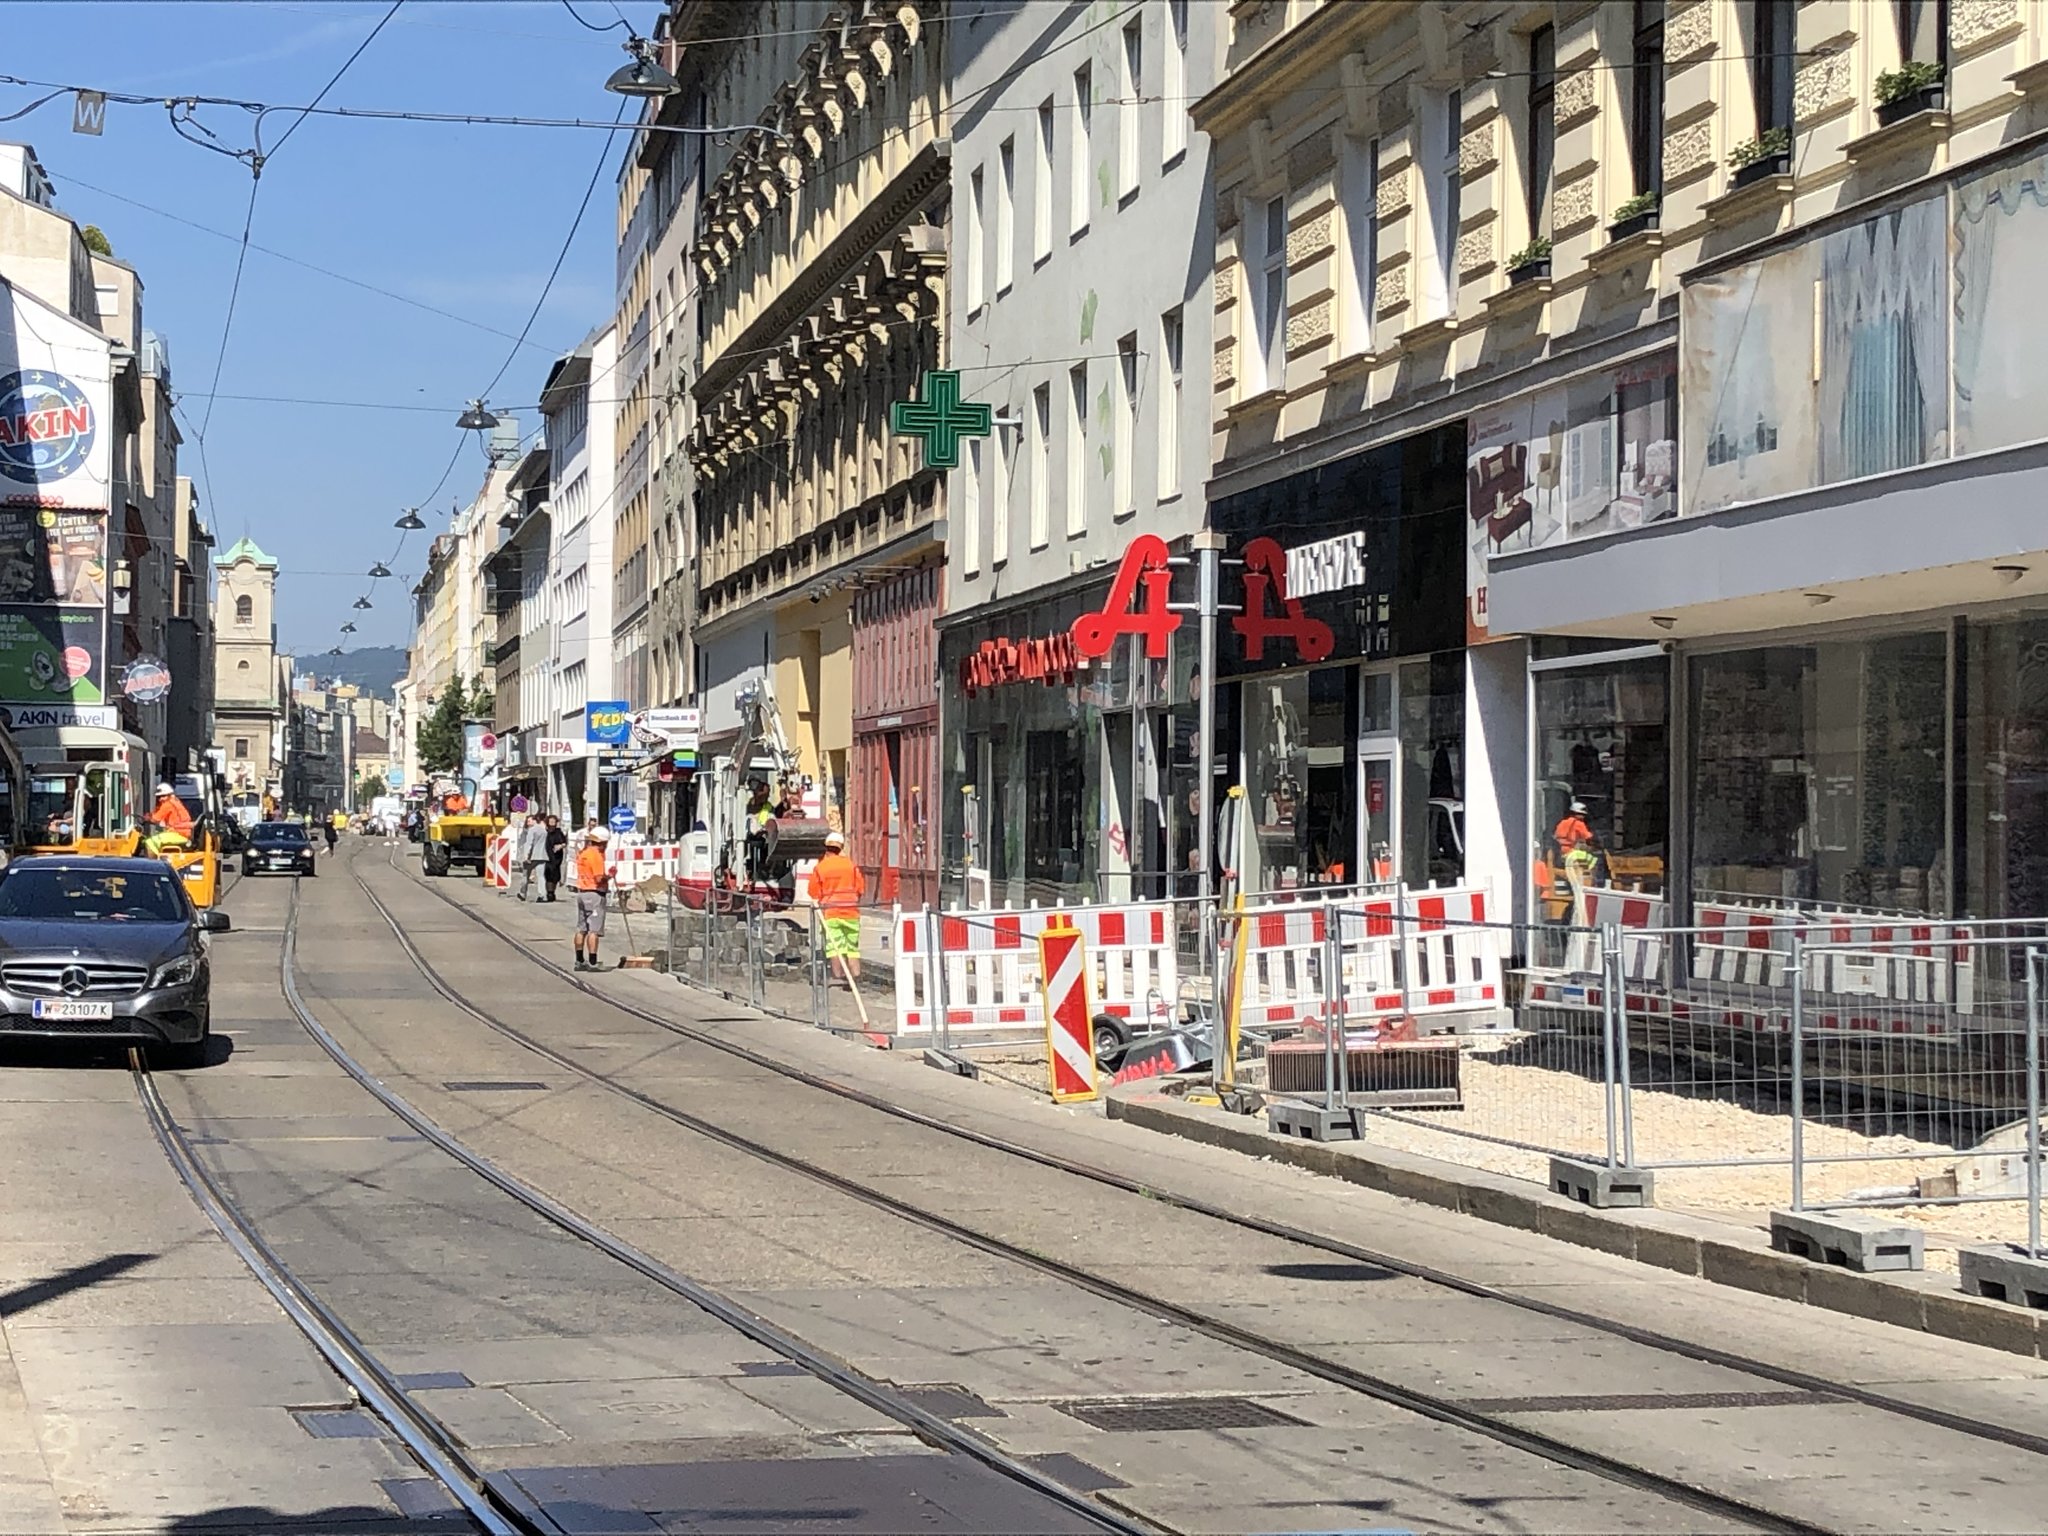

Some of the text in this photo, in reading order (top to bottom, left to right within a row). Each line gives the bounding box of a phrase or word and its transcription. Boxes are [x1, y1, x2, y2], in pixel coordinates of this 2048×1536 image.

[77, 100, 104, 128] W
[0, 403, 89, 447] AKIN
[124, 670, 171, 694] AKIN
[18, 710, 105, 725] AKIN travel
[540, 741, 573, 754] BIPA
[62, 1004, 98, 1016] 23107
[100, 1004, 108, 1016] K
